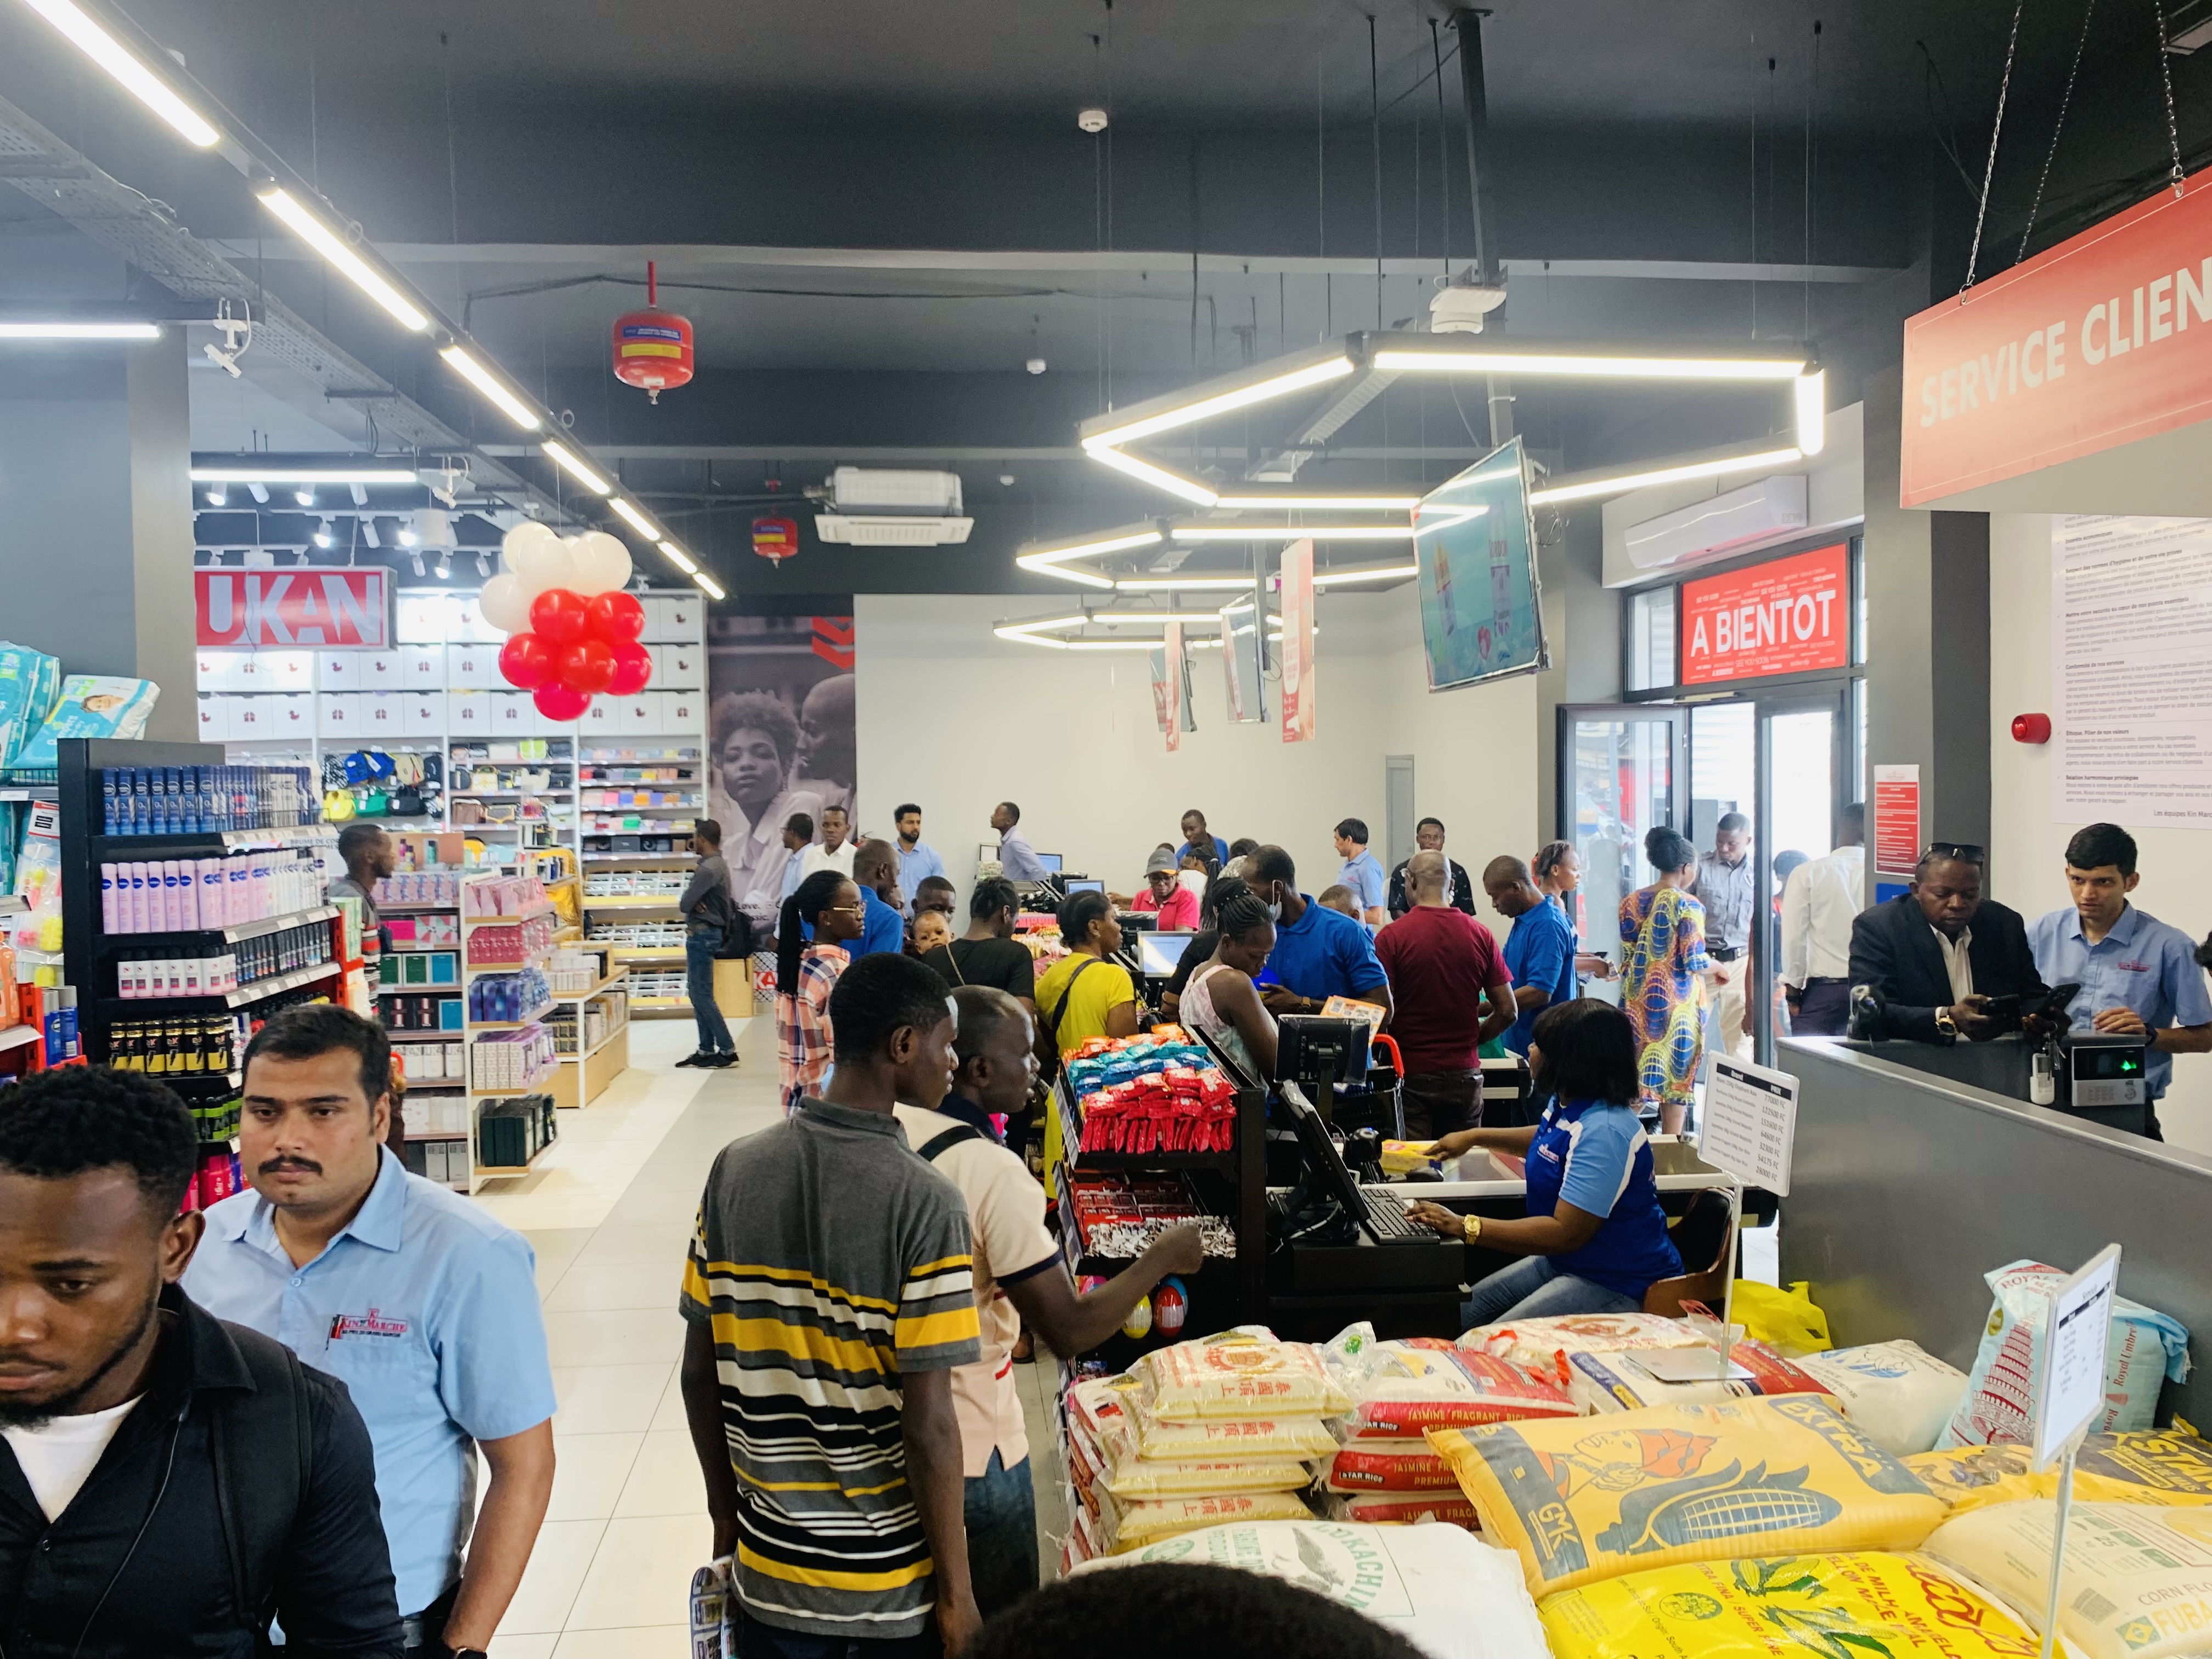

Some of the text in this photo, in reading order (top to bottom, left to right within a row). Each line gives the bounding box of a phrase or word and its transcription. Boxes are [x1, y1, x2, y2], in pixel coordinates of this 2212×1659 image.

[1920, 320, 2066, 428] SERVICE
[1690, 589, 1836, 658] A BIENTOT
[1780, 1101, 1786, 1109] FC
[1780, 1113, 1786, 1122] FC
[1778, 1125, 1784, 1135] FC
[1775, 1137, 1781, 1146] FC
[1775, 1149, 1780, 1158] FC
[1773, 1161, 1779, 1170] FC
[1771, 1173, 1778, 1182] FC
[2113, 1359, 2130, 1387] Royal
[1408, 1410, 1445, 1421] JASMINE
[1451, 1410, 1500, 1422] FRAGRANT
[1380, 1422, 1399, 1431] RICE
[1777, 1402, 1883, 1479] EXTRA
[1394, 1460, 1431, 1473] JASMINE
[2131, 1439, 2212, 1490] STA
[1364, 1474, 1384, 1483] RICE
[1538, 1501, 1579, 1551] GMK
[1854, 1561, 1876, 1573] DE
[2137, 1583, 2185, 1606] CORN
[1713, 1579, 1734, 1601] FINA
[1733, 1605, 1764, 1633] SUPER
[1666, 1635, 1683, 1656] South
